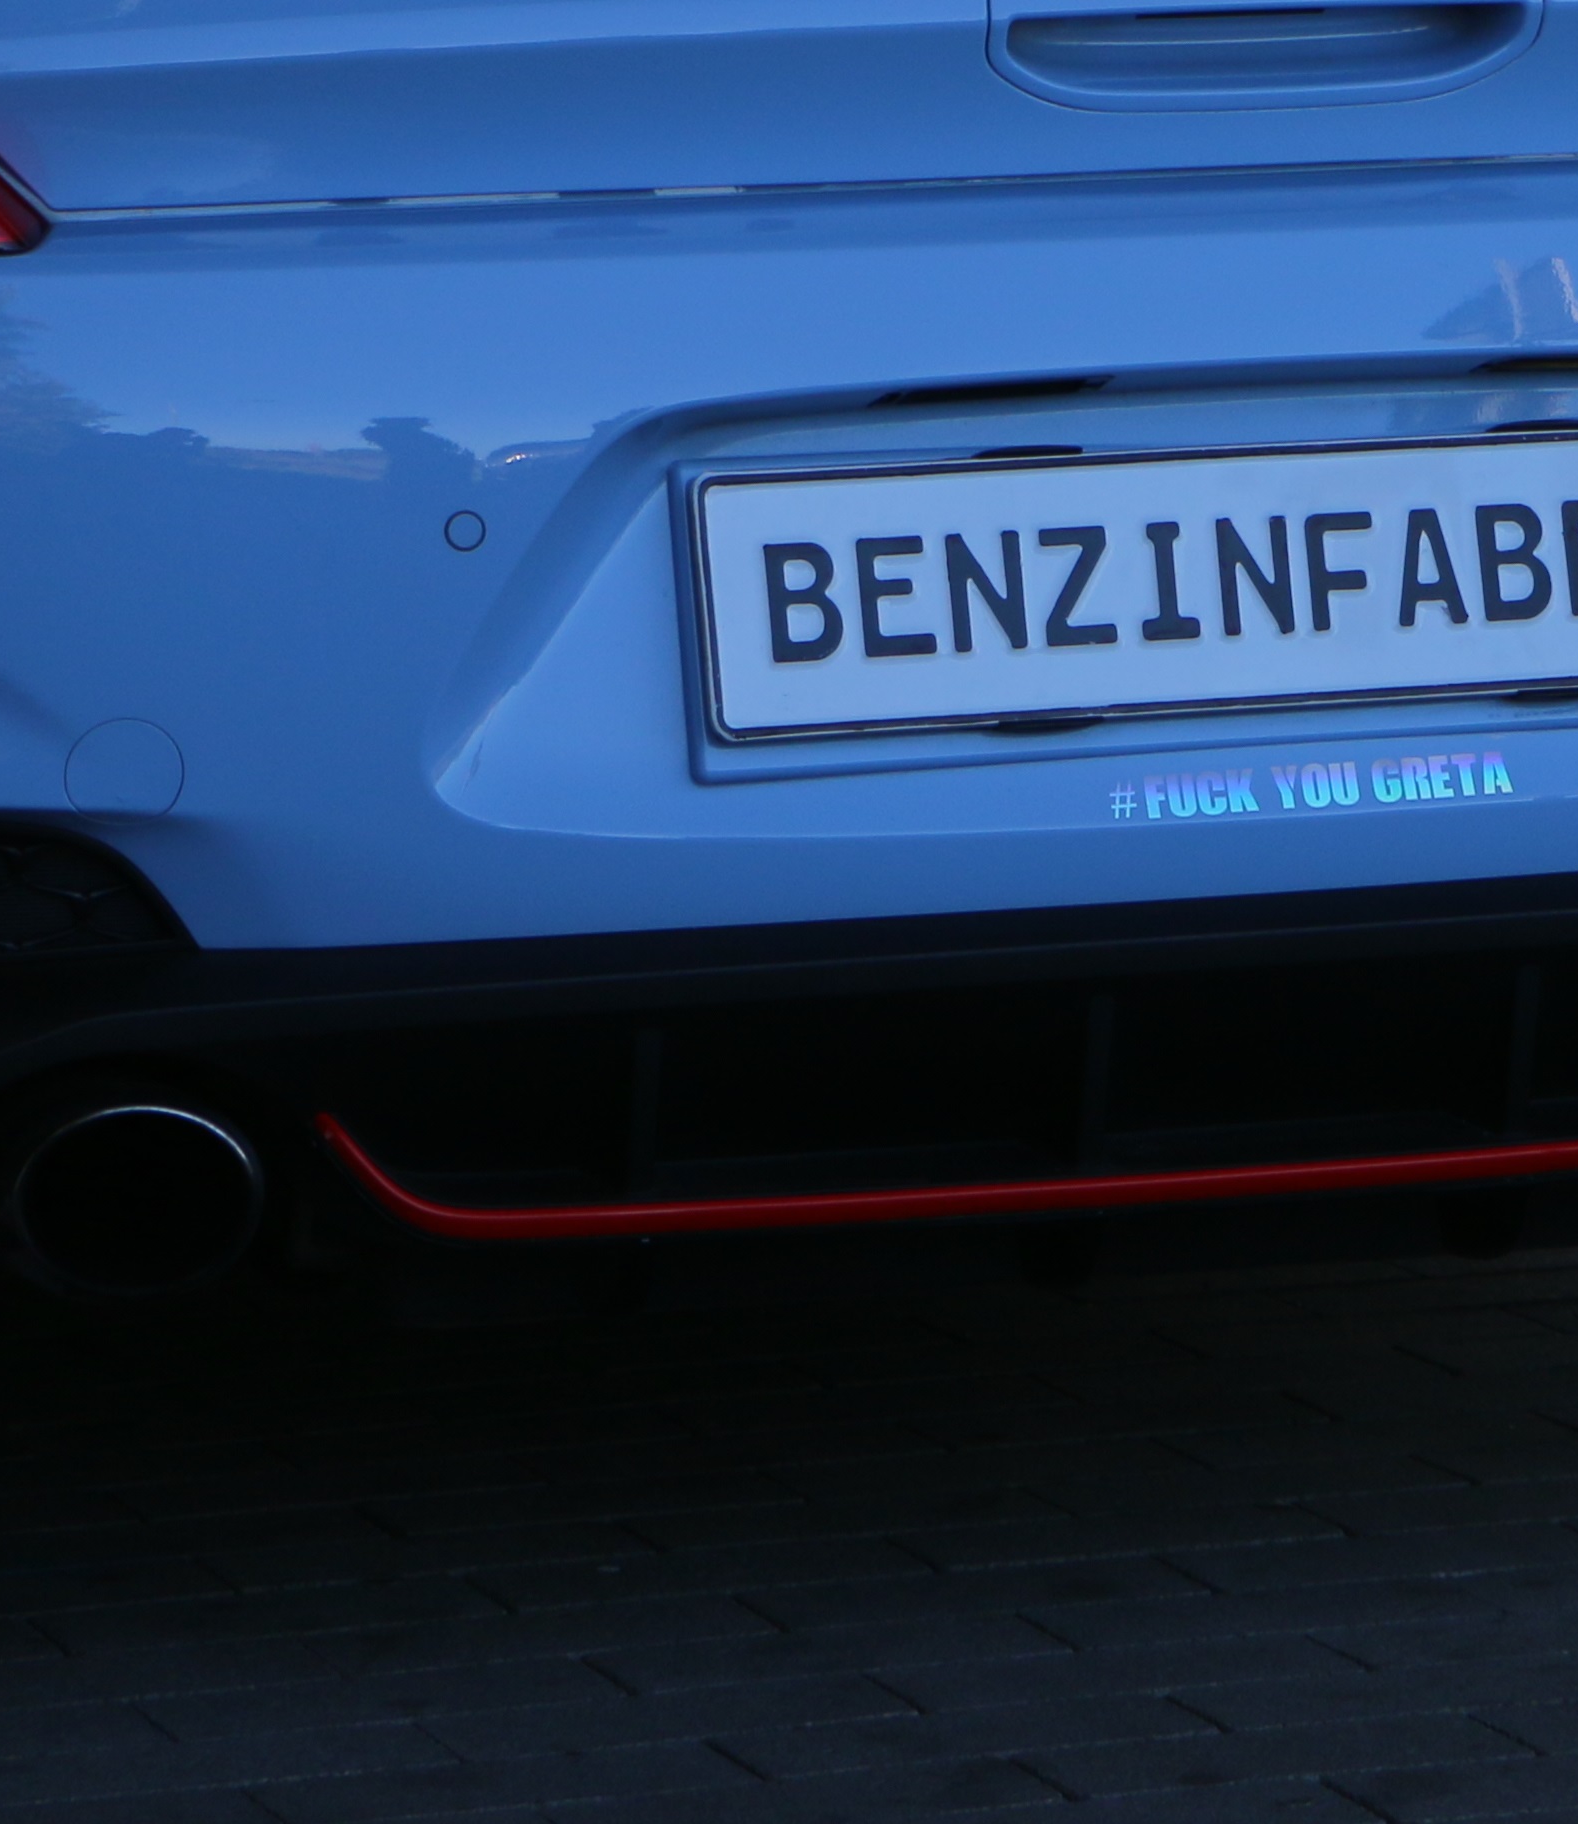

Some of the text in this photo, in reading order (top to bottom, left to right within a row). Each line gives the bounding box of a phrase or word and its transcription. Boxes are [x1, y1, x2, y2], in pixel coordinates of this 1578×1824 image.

[1109, 751, 1514, 819] #FUCK YOU GRETA
